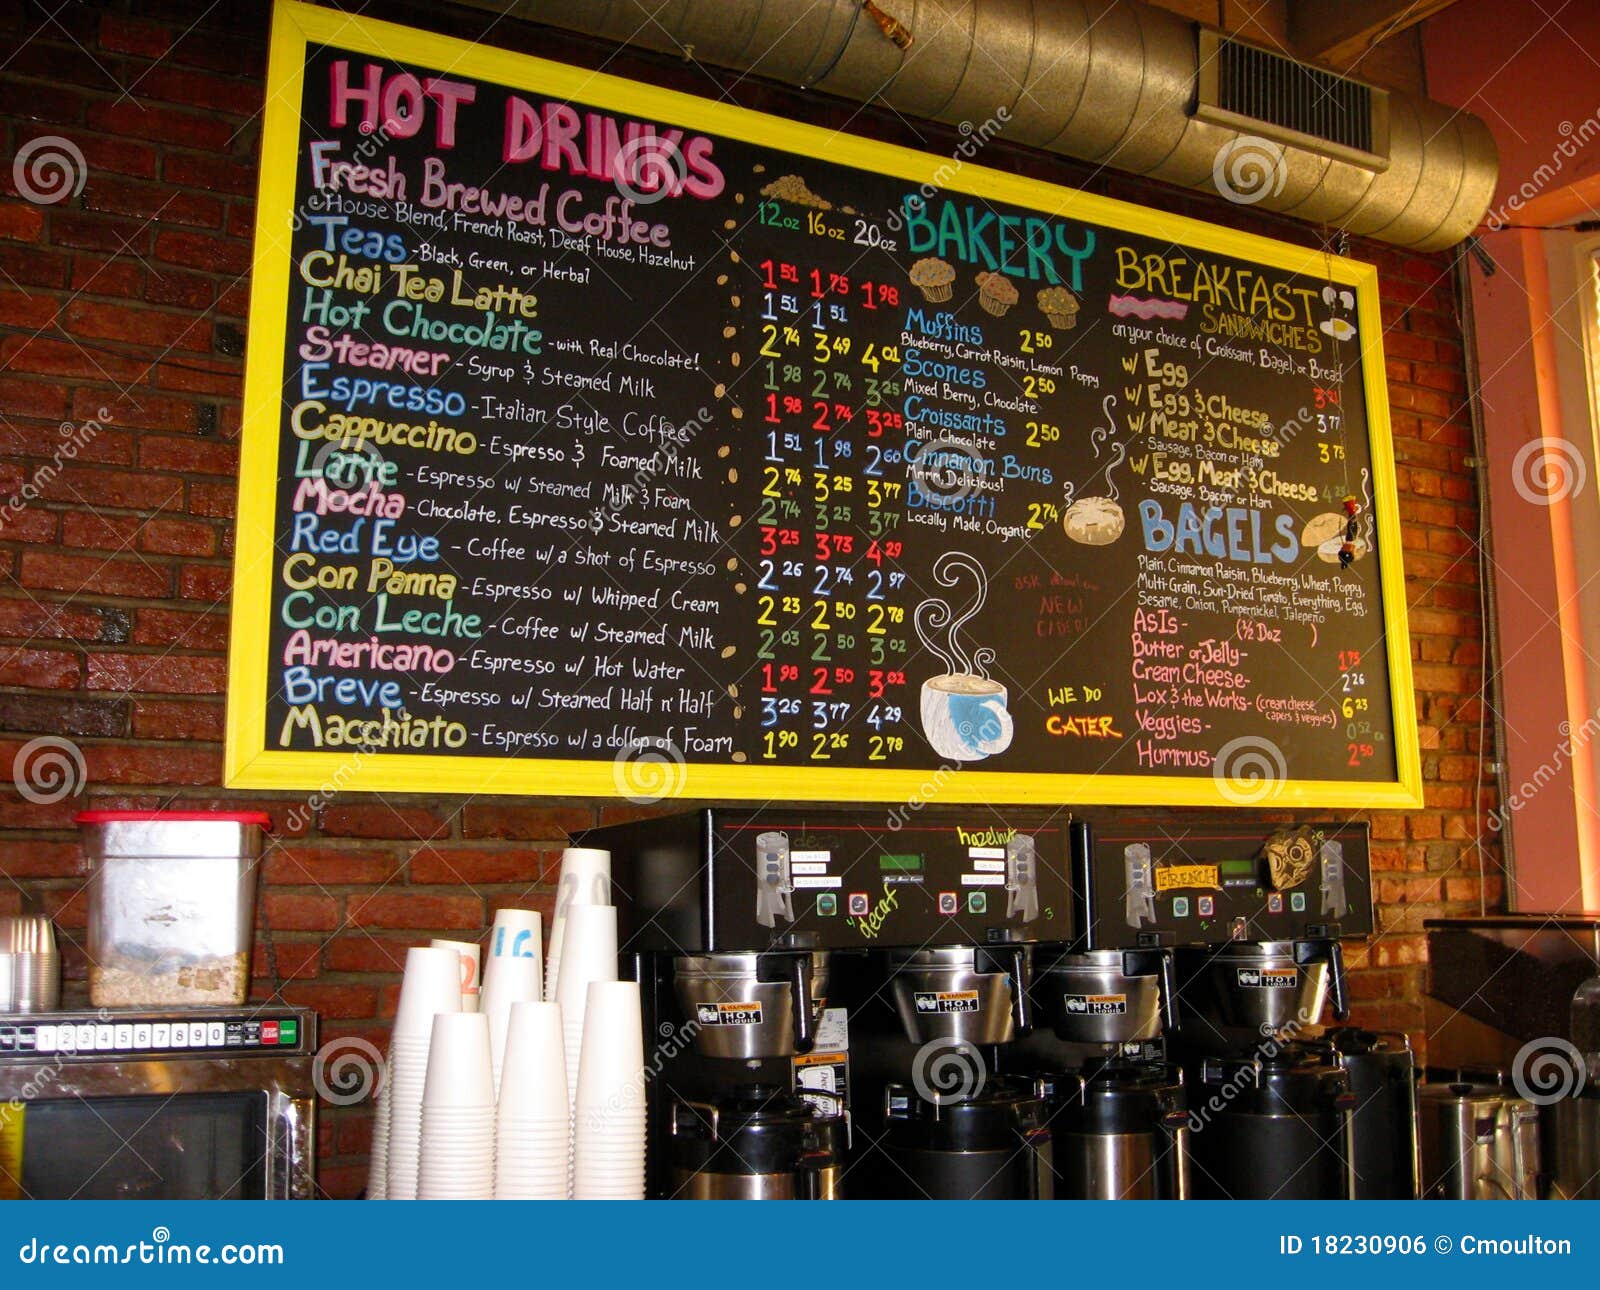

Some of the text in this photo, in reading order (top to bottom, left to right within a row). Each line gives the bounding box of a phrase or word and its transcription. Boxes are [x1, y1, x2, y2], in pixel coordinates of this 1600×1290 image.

[329, 60, 726, 199] HOT DRINKS
[310, 141, 671, 247] Fresh Brewed Coffee
[310, 215, 406, 263] Teas
[521, 263, 537, 276] or
[543, 260, 590, 284] Herbal
[395, 202, 696, 271] Blend, French Roast, Decaf House, Hazelnut
[903, 193, 1096, 292] BAKERY
[300, 251, 538, 319] Chai Tea Latte
[1115, 246, 1318, 327] BREAKFAST
[302, 286, 701, 371] Hot Chocolate Real Chocolate!
[904, 307, 983, 346] Muffins
[1200, 303, 1322, 354] SANDWICHES
[299, 325, 451, 376] Steamer
[467, 356, 515, 382] Syrup
[542, 367, 611, 393] Steamed
[619, 375, 656, 399] Milk
[903, 348, 987, 389] Scones
[956, 343, 992, 362] Carrot
[1031, 359, 1063, 377] Lemon
[1070, 365, 1099, 389] Poppy
[1144, 348, 1188, 388] Egg
[1156, 325, 1187, 349] choice
[1190, 334, 1201, 359] of
[1310, 359, 1343, 383] Bread
[301, 362, 690, 444] Espresso Style Coffee
[903, 395, 1006, 437] Croissants
[904, 378, 938, 400] Mixed
[983, 391, 1038, 415] Chocolate
[1148, 383, 1270, 429] Egg Cheese
[291, 400, 703, 480] Cappuccino Foamed Milk
[939, 428, 997, 451] Chocolate
[1150, 411, 1280, 458] Meat Cheese
[1195, 445, 1227, 462] Bacon
[1241, 453, 1264, 471] Ham
[294, 440, 690, 511] Latte Espresso Foam
[903, 439, 1053, 485] Cinnamon Buns
[1199, 461, 1242, 488] Meat
[1259, 471, 1318, 503] Cheese
[292, 479, 719, 543] Mocha Espresso Steamed Milk
[906, 481, 996, 518] Biscotti
[290, 513, 716, 577] Red Eye Coffee shot of Espresso
[907, 510, 947, 532] Locally
[986, 519, 1031, 543] Organic
[1138, 498, 1299, 564] BAGELS
[282, 552, 719, 615] Con Panna Whipped Cream
[1168, 557, 1214, 579] Cinnamon
[281, 590, 716, 650] Con Leche Coffee Steamed Milk
[1132, 632, 1184, 658] Butter
[283, 630, 684, 680] Americano Hot Water
[1133, 658, 1180, 682] Cream
[283, 666, 714, 717] Breve Espresso Half Half
[1048, 686, 1102, 707] WE DO
[1133, 683, 1167, 704] Lox
[1182, 688, 1202, 708] the
[279, 704, 733, 755] Macchiato dollop Foam
[1046, 715, 1123, 739] CATER
[957, 826, 1017, 847] hazelnut
[1158, 867, 1217, 887] FRENCH
[859, 882, 899, 939] decaf
